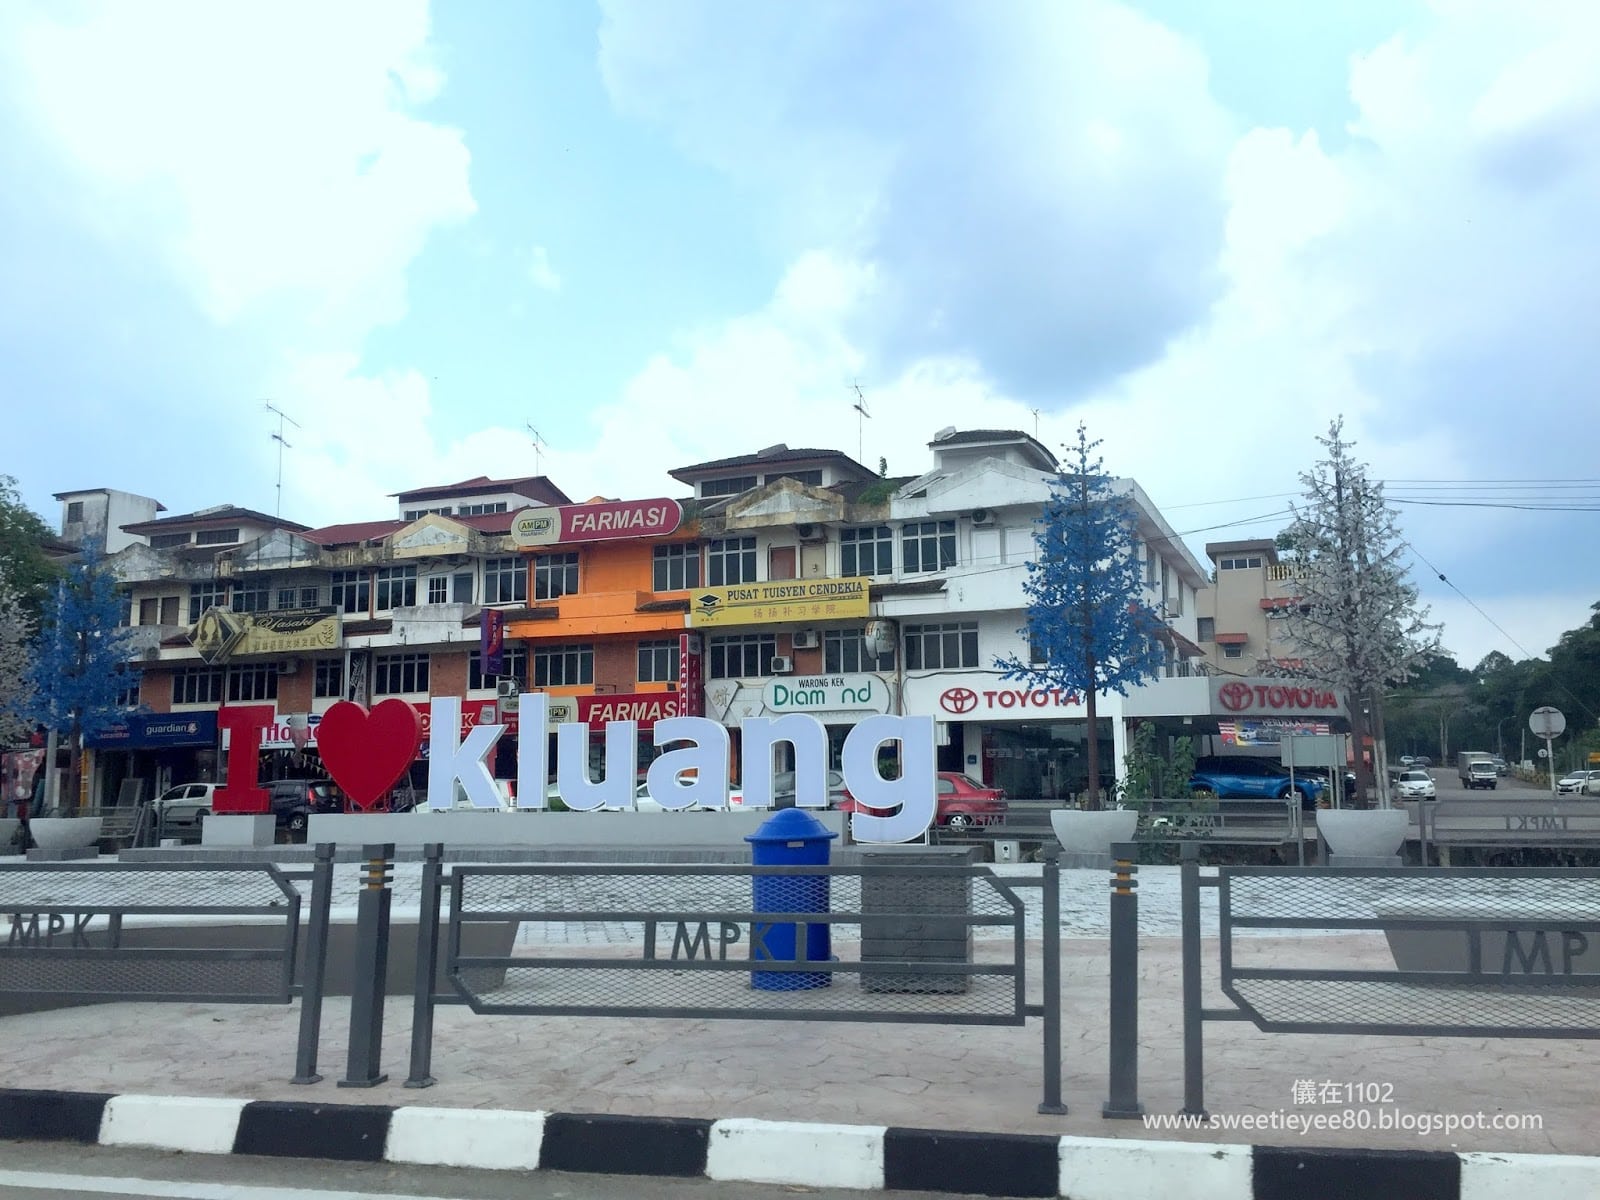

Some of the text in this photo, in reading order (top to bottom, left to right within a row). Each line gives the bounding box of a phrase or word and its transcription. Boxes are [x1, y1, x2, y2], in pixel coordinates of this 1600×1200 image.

[570, 507, 667, 533] FARMASI
[727, 582, 863, 601] PUSAT TUISYEN CENDEKIA
[257, 617, 315, 630] Yasaki
[799, 678, 845, 688] WARONG KEK
[983, 689, 1081, 709] TOYOTA
[1254, 685, 1338, 709] TOYOTA
[588, 700, 680, 723] FARMAS
[146, 723, 187, 736] guardian
[428, 692, 938, 843] kluang
